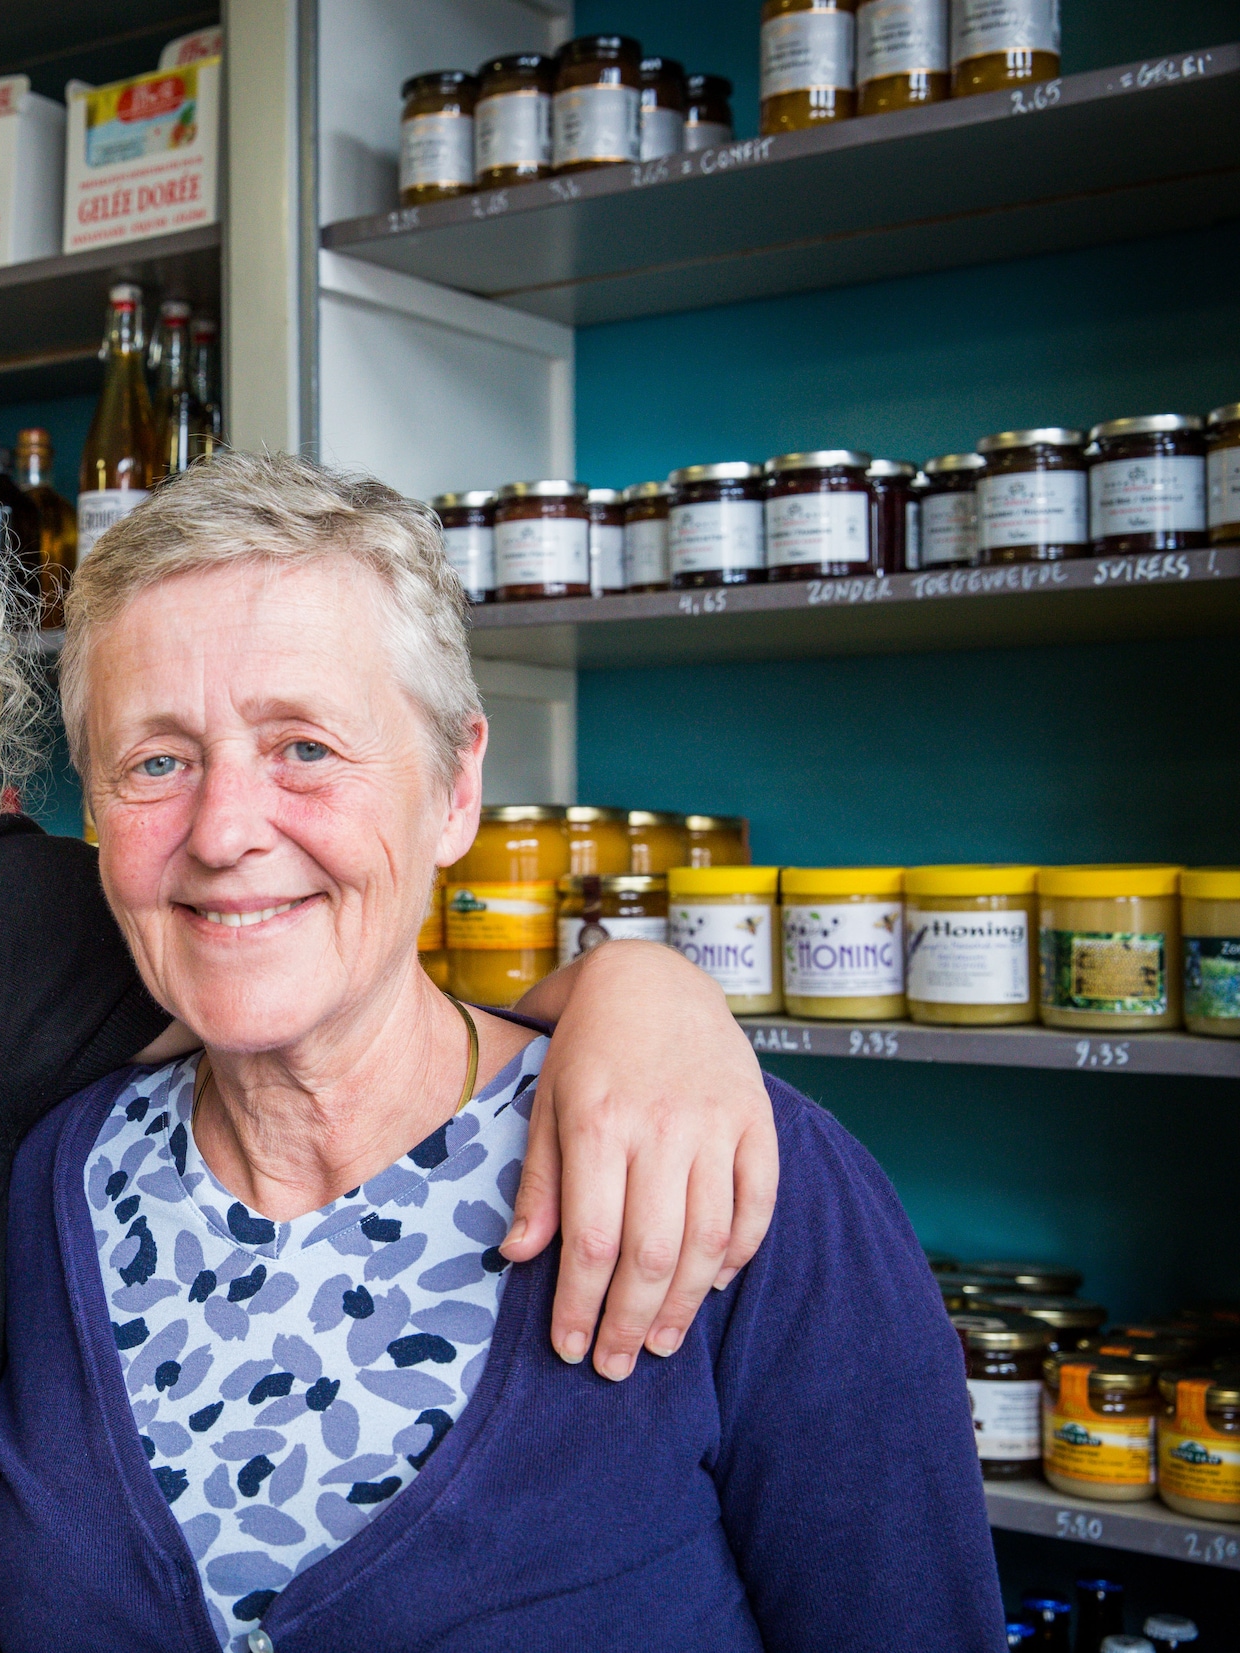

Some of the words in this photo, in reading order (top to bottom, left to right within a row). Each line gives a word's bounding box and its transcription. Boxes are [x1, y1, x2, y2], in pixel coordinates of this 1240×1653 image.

[1010, 78, 1062, 115] 2.65
[77, 183, 132, 226] GELÉE
[137, 170, 202, 213] DORÉE
[807, 576, 892, 604] ZONDER
[932, 919, 1024, 944] Honing
[798, 940, 893, 970] HONING
